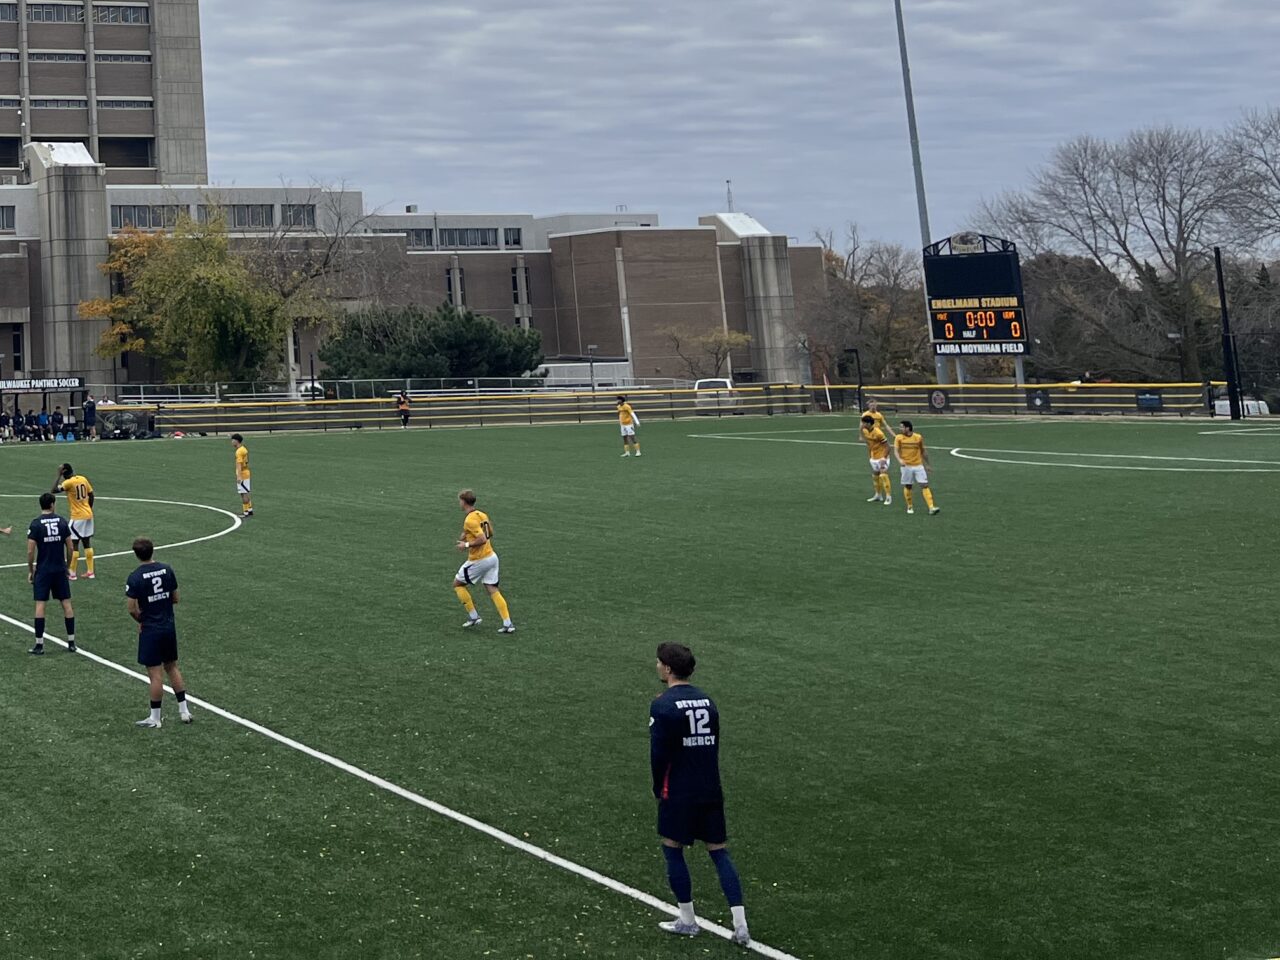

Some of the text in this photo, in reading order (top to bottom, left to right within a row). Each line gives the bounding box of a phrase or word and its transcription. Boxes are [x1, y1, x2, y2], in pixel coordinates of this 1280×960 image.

[932, 297, 1018, 309] ENGELMANN STADIUM
[966, 312, 995, 327] 0:00
[945, 323, 954, 338] 0
[962, 330, 976, 338] HALF
[1011, 321, 1020, 337] 0
[936, 343, 1024, 353] LAURA MOYNIHAN FIELD
[31, 379, 58, 388] PANTHER
[58, 378, 80, 387] SOCCER
[76, 484, 86, 500] 10
[45, 523, 59, 536] 15
[152, 577, 163, 594] 2
[148, 592, 170, 603] MERCY
[675, 699, 710, 709] DETROIT
[685, 708, 711, 735] 12
[682, 735, 715, 747] MERCY
